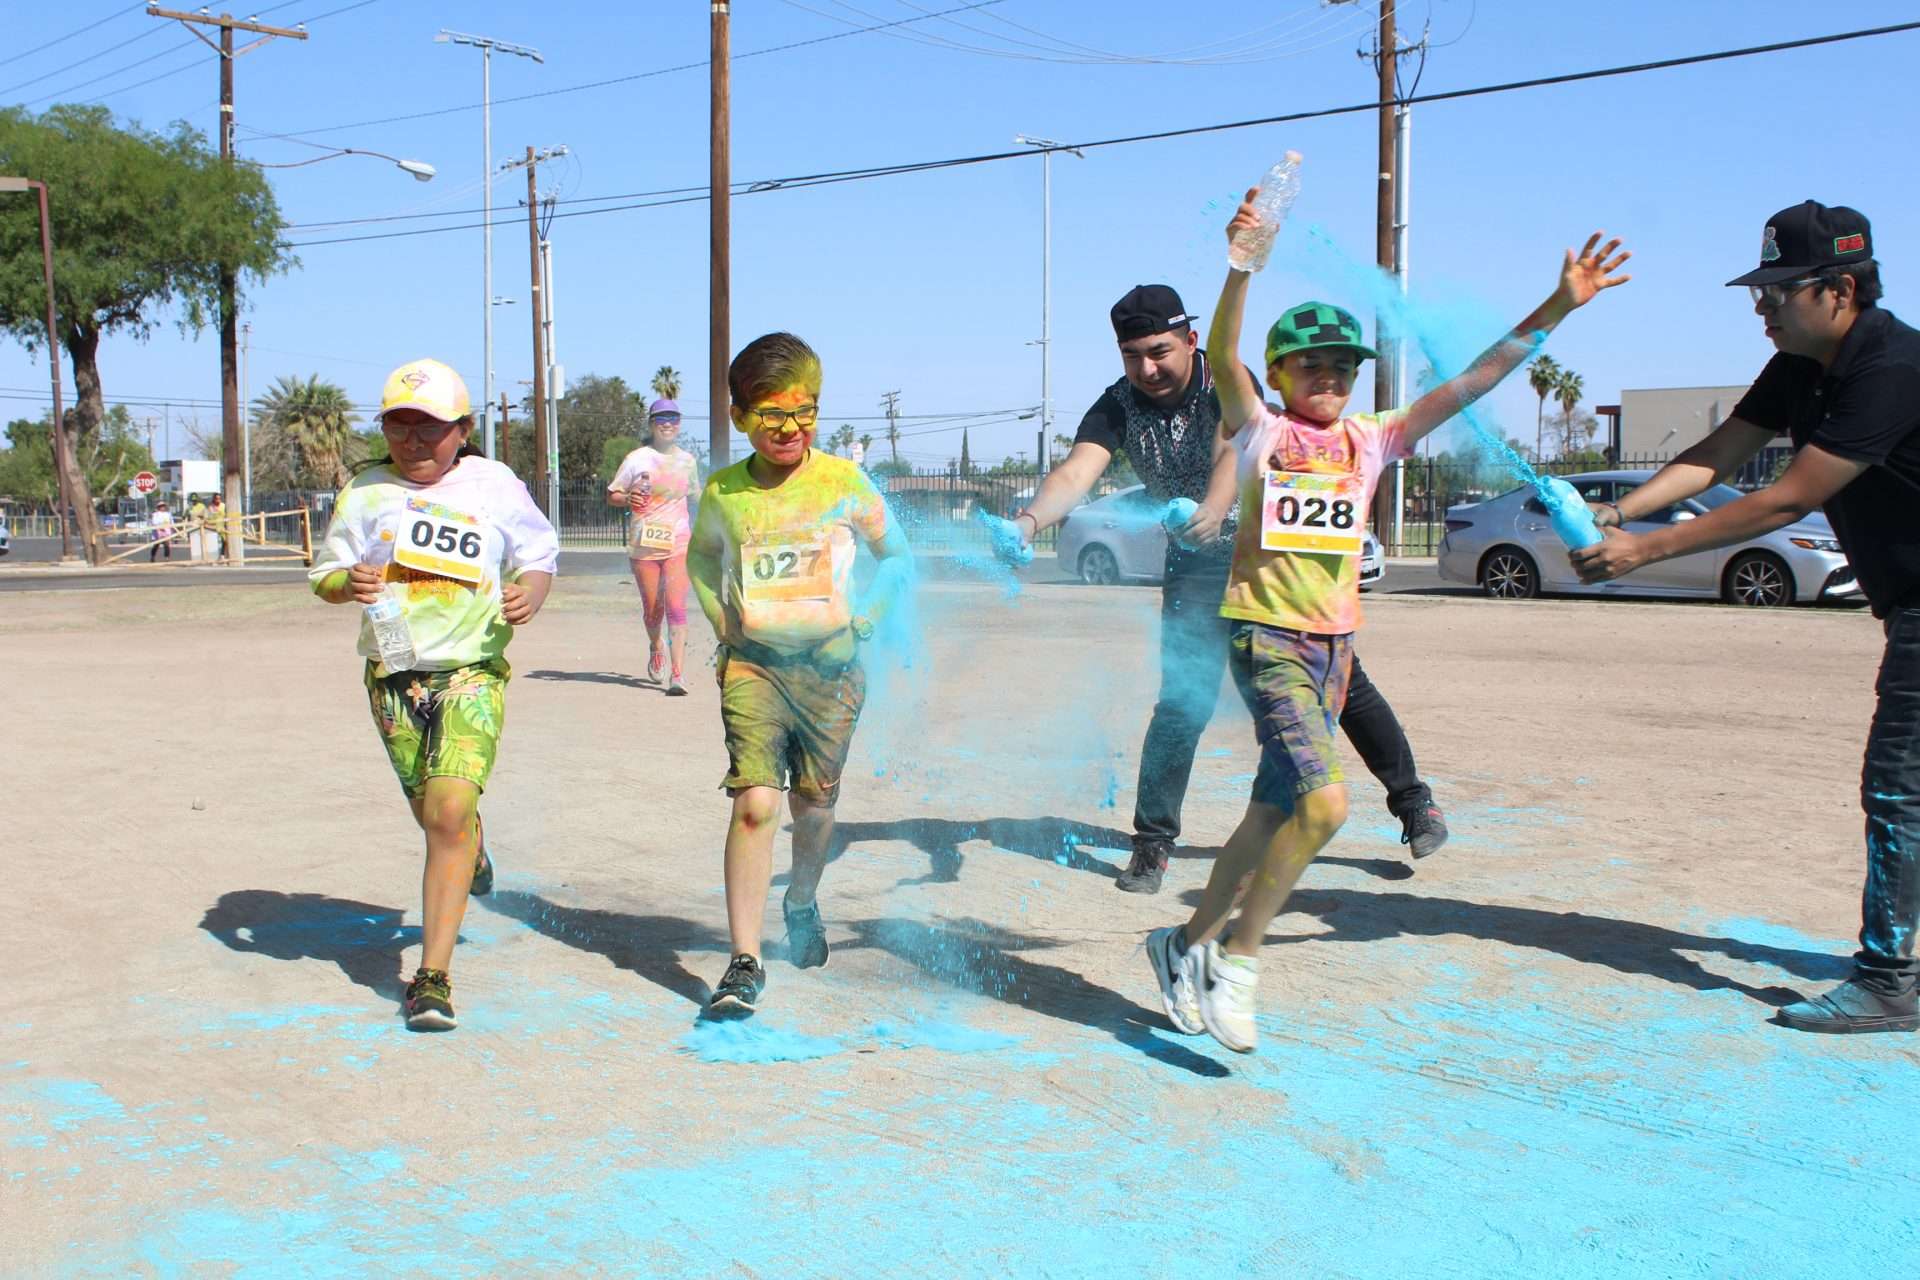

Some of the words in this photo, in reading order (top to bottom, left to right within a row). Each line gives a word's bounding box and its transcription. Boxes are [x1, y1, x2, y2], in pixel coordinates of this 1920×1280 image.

[135, 478, 155, 487] STOP
[1276, 496, 1354, 529] 028
[411, 520, 482, 558] 056
[646, 528, 672, 541] 022
[753, 550, 823, 580] 027
